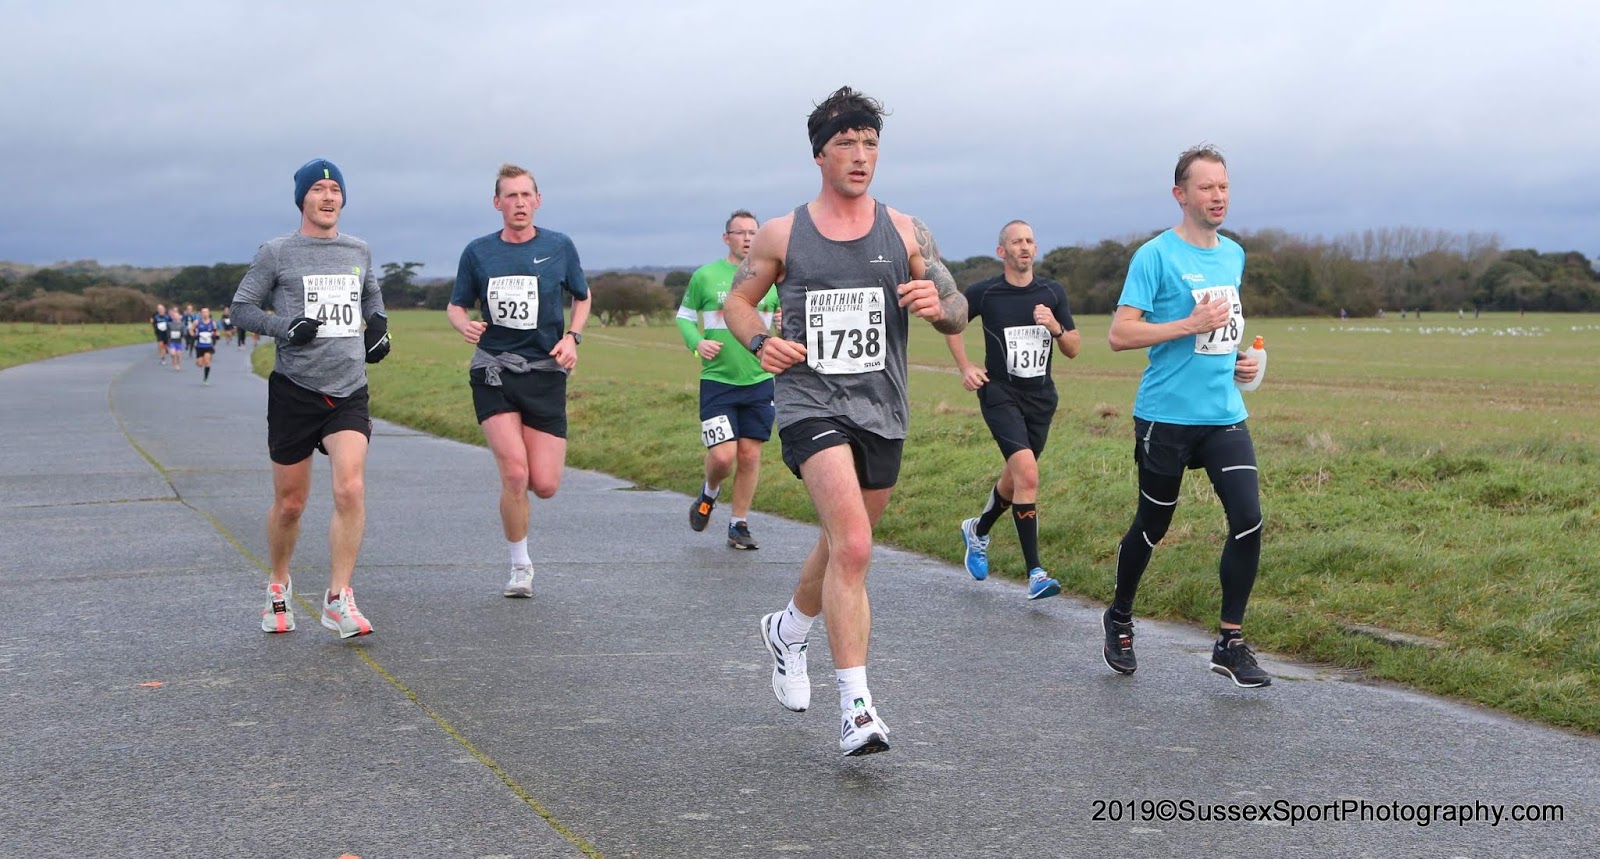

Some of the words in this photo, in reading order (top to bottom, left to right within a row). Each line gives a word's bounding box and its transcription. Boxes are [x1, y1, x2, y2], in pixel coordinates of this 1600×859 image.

[307, 277, 346, 286] WORTHING
[810, 292, 864, 306] WORTHING
[316, 303, 353, 326] 440
[498, 301, 529, 320] 523
[817, 328, 880, 360] 1738
[1013, 350, 1046, 369] 1316
[703, 426, 725, 446] 793
